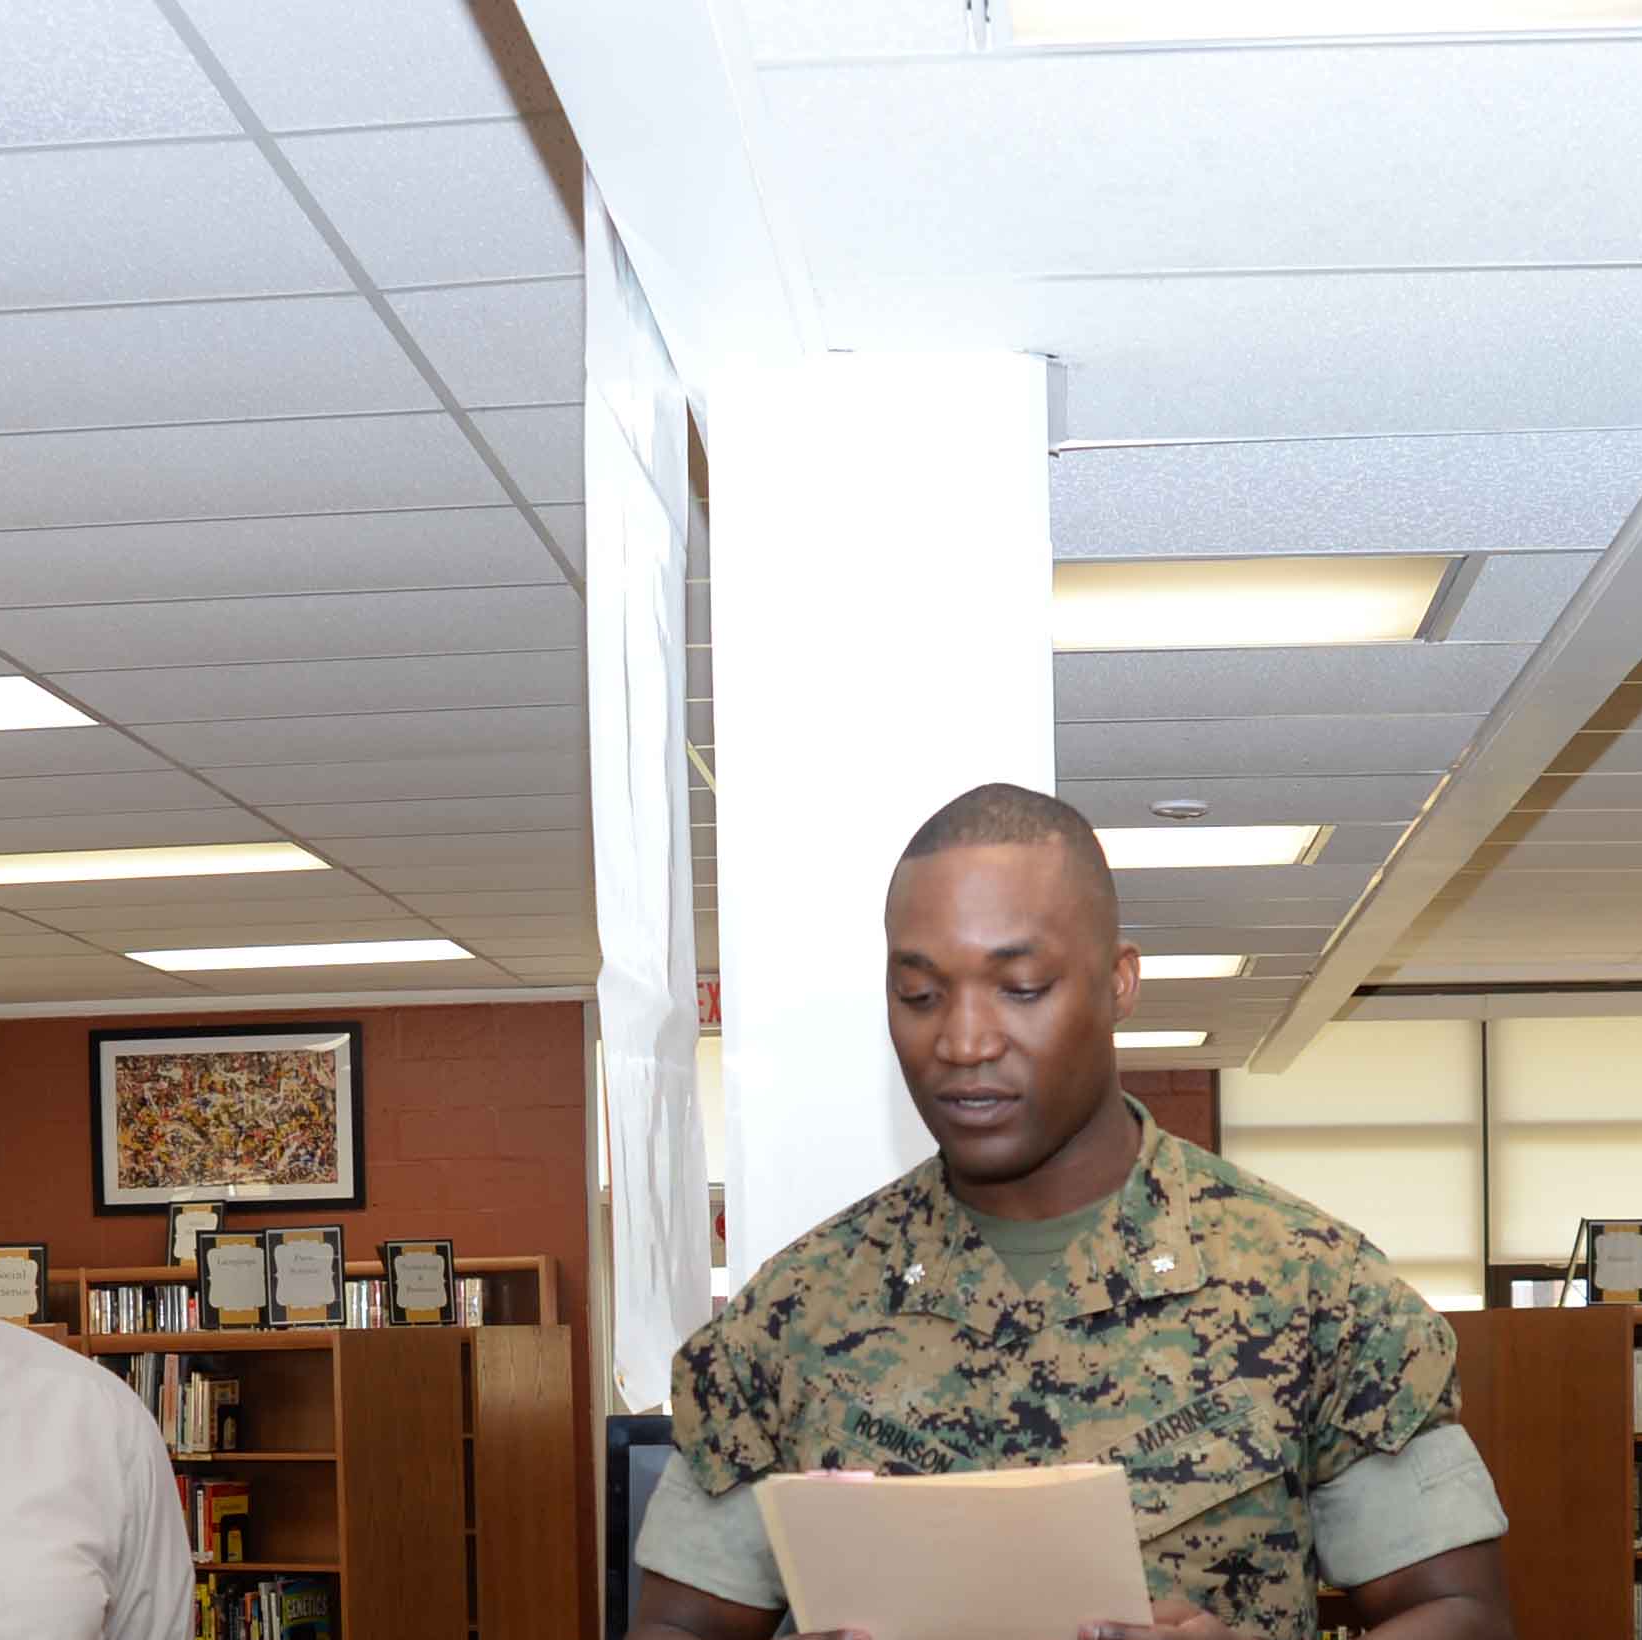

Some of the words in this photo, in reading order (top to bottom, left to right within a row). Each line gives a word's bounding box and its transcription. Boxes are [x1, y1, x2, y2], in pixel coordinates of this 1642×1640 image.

[856, 1411, 955, 1473] ROBINSON
[1136, 1393, 1231, 1456] MARINES
[287, 1598, 327, 1618] GENETICS
